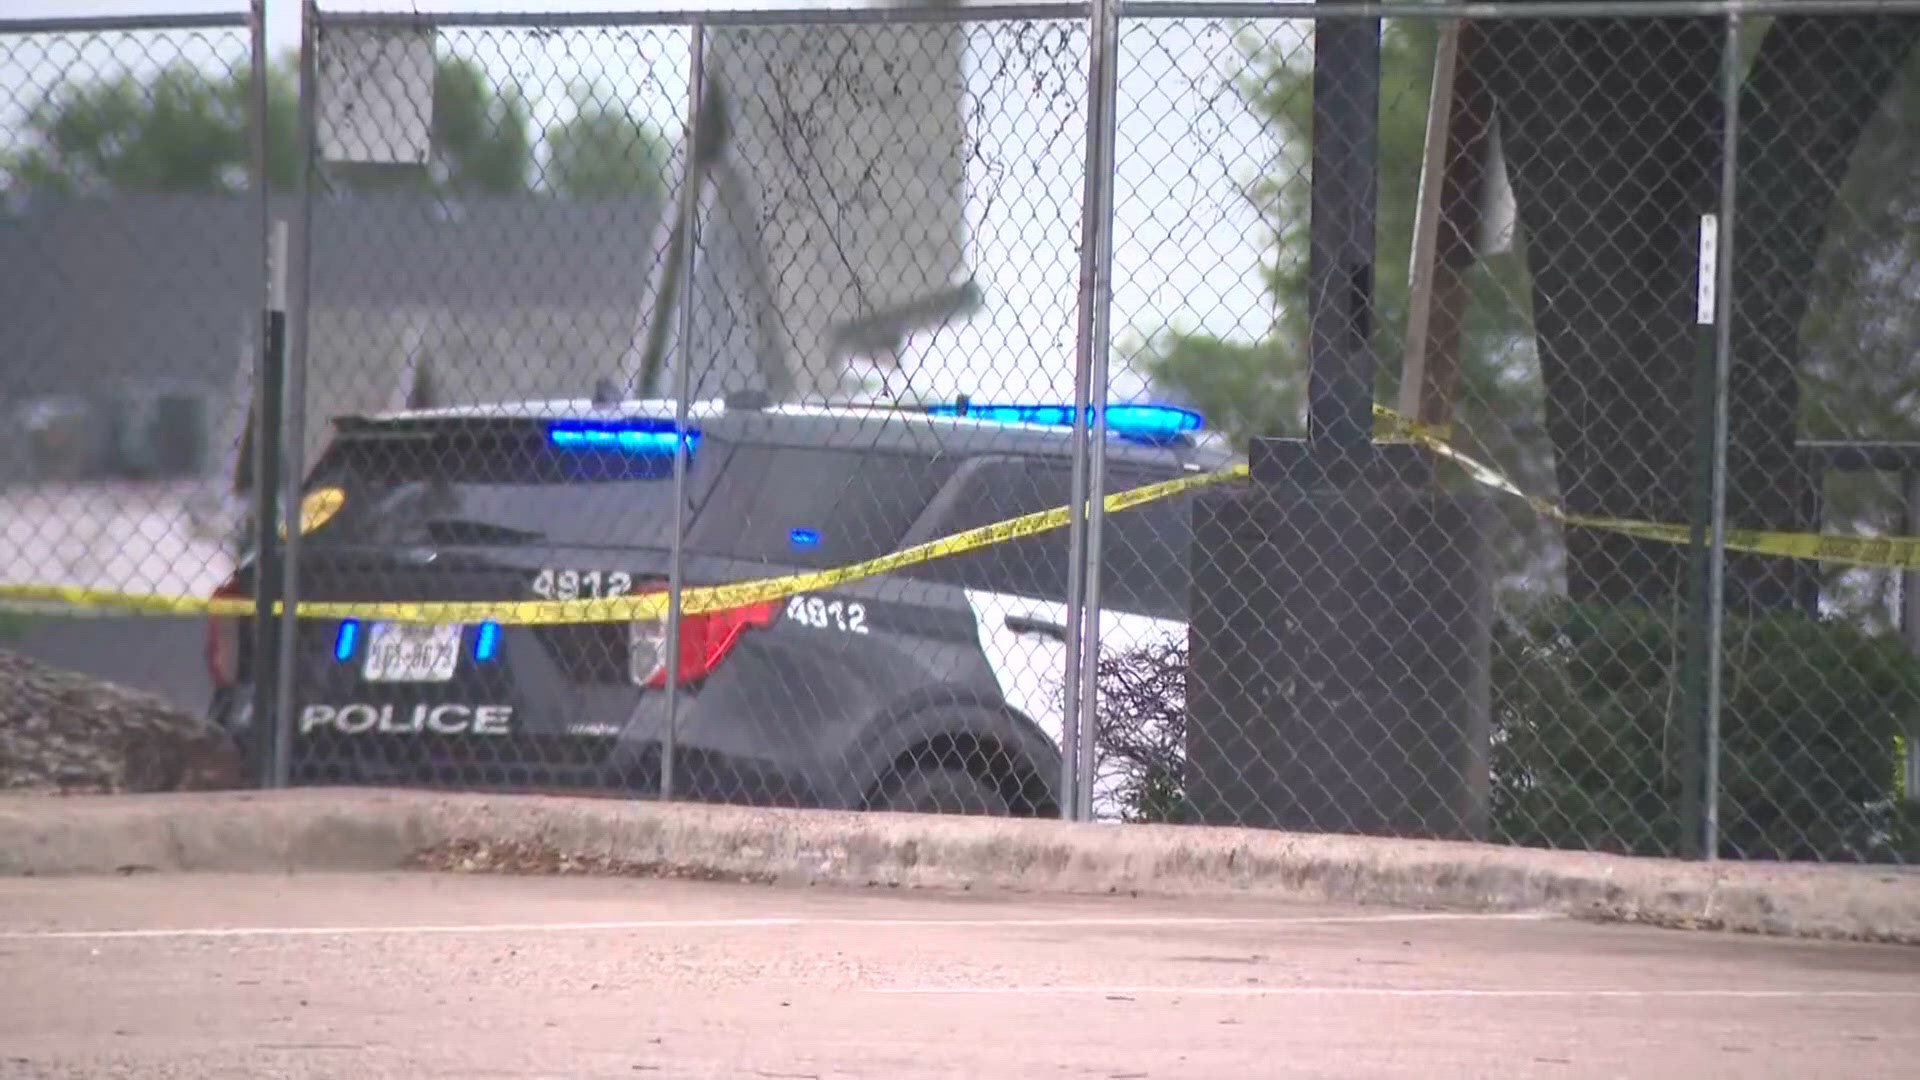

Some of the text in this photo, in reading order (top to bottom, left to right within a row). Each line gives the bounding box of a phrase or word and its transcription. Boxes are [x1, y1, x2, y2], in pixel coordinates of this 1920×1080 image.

[533, 569, 632, 600] 4912
[787, 596, 869, 635] 4912
[299, 702, 514, 736] POLICE
